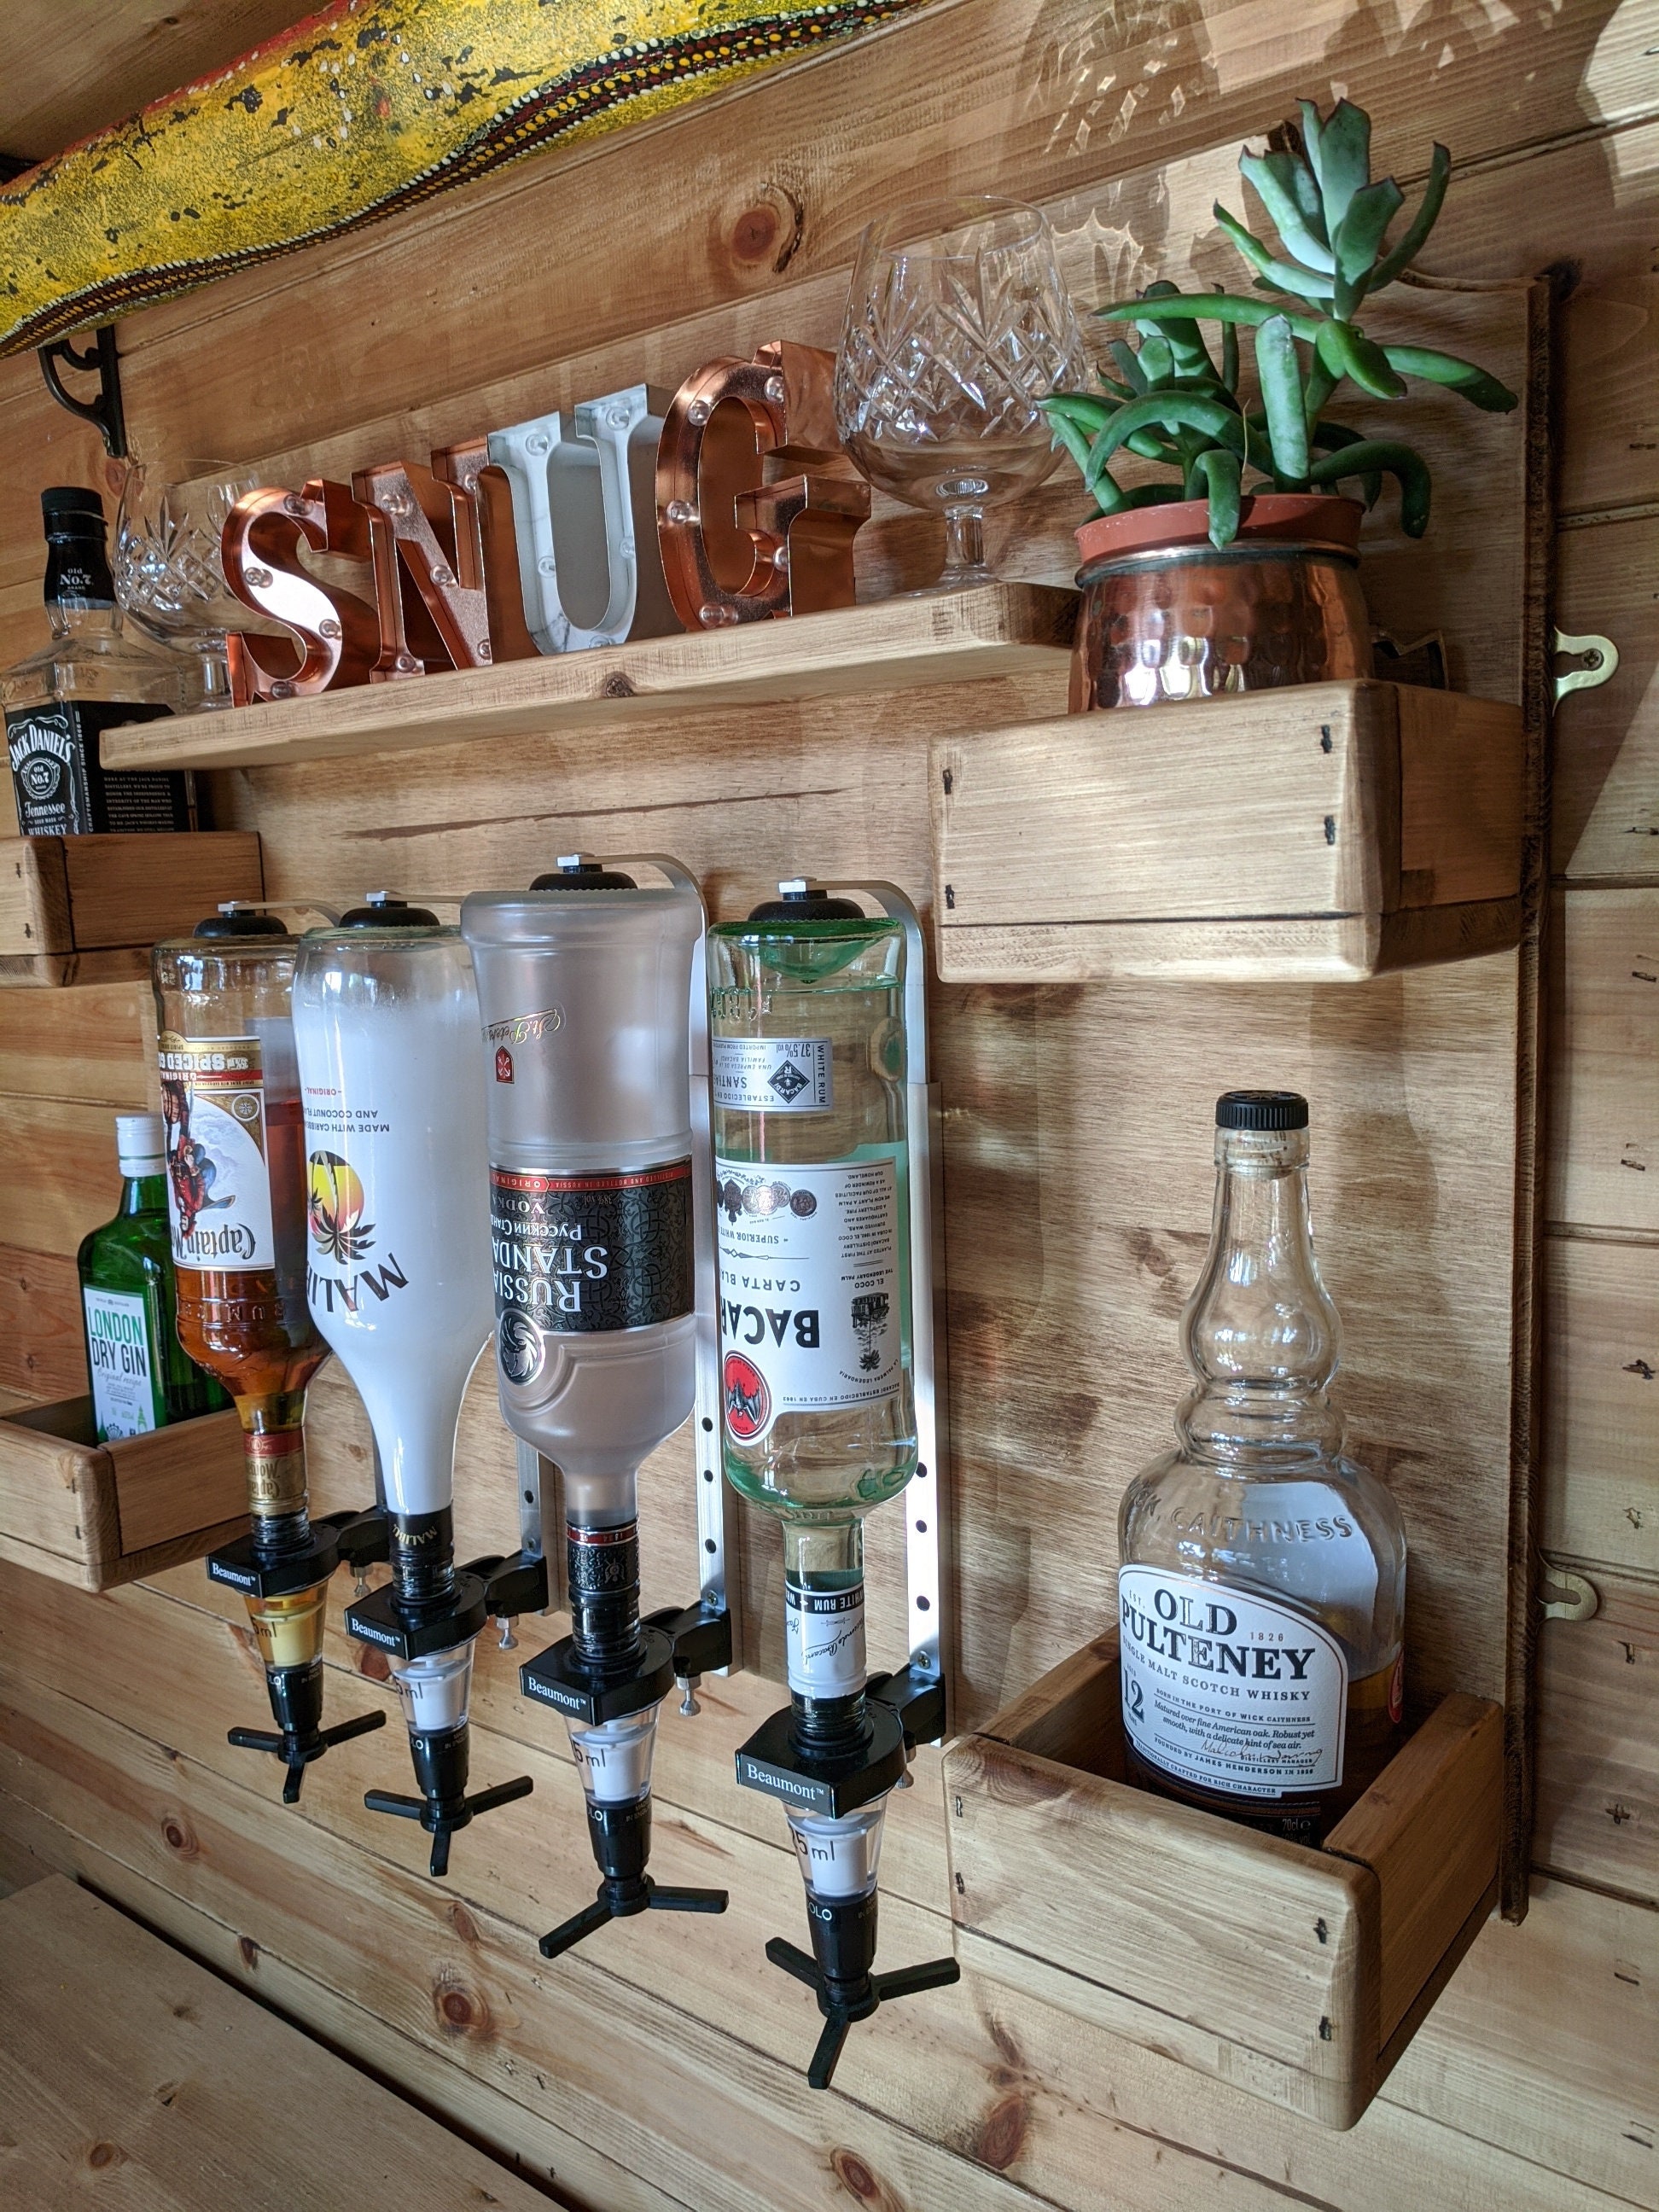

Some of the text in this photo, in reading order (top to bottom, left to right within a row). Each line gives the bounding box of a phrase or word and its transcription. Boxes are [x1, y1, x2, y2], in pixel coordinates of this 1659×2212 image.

[221, 338, 872, 708] SNUG
[9, 724, 76, 772] JACK DANIEL'S
[25, 801, 66, 818] Tennessee
[28, 824, 67, 835] WHISKEY
[166, 1052, 224, 1072] SPICED
[784, 1043, 811, 1058] 37.5%
[817, 1045, 827, 1104] WHITE RUM
[312, 1109, 379, 1119] AND COCONUT
[724, 1092, 775, 1103] ESTABLECIDO
[331, 1123, 390, 1133] MADE WITH
[492, 1194, 546, 1214] VODKA
[186, 1223, 257, 1262] Captain
[736, 1231, 780, 1245] SUPERIOR
[742, 1276, 800, 1293] CARTA
[854, 1279, 875, 1289] COCO
[87, 1306, 144, 1347] LONDON
[91, 1336, 147, 1377] DRY GIN
[393, 1525, 438, 1545] MALIBU
[813, 1598, 836, 1611] RUM
[1154, 1588, 1238, 1636] OLD
[1121, 1593, 1316, 1679] PULTENEY
[1249, 1631, 1284, 1643] 1826
[1122, 1634, 1311, 1702] SINGLE MALT SCOTCH WHISKY
[1123, 1668, 1145, 1724] 12
[1155, 1687, 1312, 1723] BORN IN THE PORT OF WICK CAITHNESS
[1154, 1699, 1315, 1741] Matured over fine American oak. Robust yet
[1162, 1716, 1189, 1734] smooth,
[1188, 1726, 1206, 1738] with
[1213, 1732, 1244, 1746] delicate
[1244, 1737, 1262, 1749] hint
[1262, 1738, 1272, 1751] of
[1272, 1741, 1287, 1749] sea
[1287, 1740, 1302, 1749] air.
[1135, 1740, 1277, 1795] TRADITIONALLY CRAFTED FOR RICH CHARACTER
[1154, 1736, 1183, 1756] FOUNDED
[1184, 1750, 1194, 1760] BY
[1194, 1754, 1223, 1769] JAMES
[1225, 1761, 1283, 1776] HENDERSON
